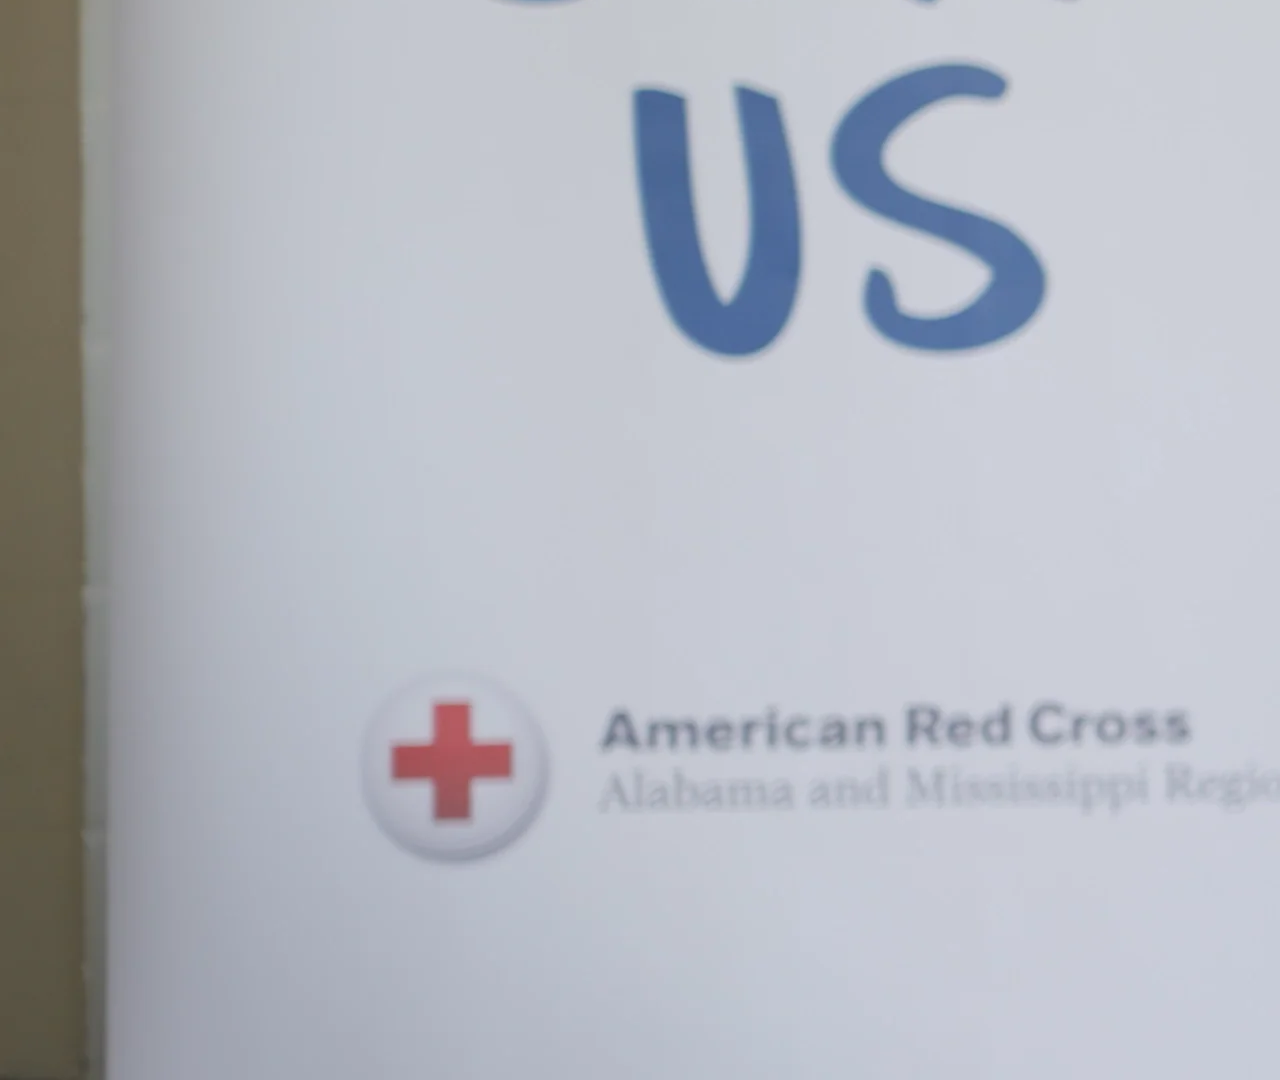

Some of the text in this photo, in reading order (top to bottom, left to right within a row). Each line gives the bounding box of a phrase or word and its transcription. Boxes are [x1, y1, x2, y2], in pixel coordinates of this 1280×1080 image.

[632, 61, 1048, 358] US
[601, 702, 1191, 753] American Red Cross
[599, 768, 794, 812] Alabama
[809, 766, 890, 809] and
[906, 764, 1149, 818] Mississippi
